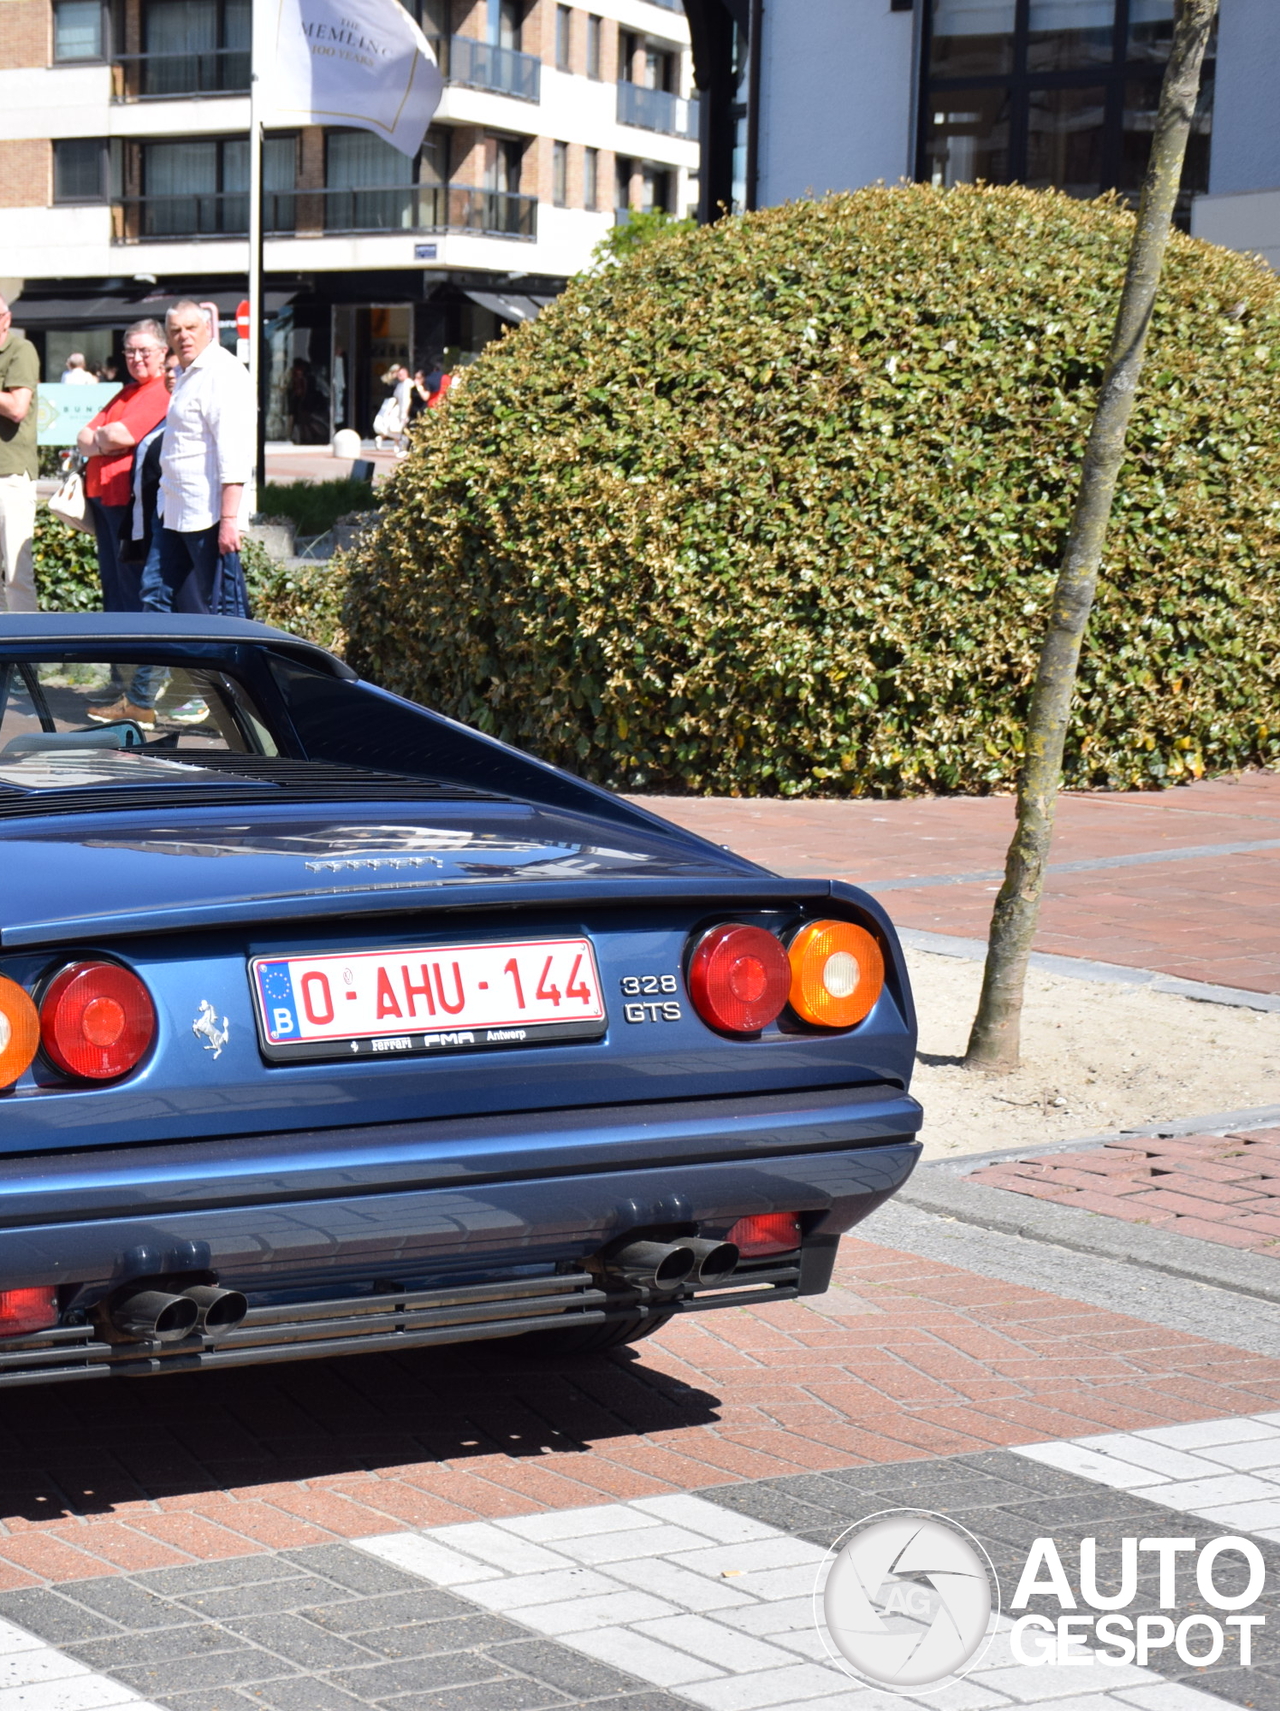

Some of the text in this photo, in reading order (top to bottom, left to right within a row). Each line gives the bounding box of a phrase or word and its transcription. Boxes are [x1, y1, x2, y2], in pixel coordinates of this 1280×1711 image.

[312, 45, 374, 68] 100 YEARS
[622, 974, 678, 994] 328
[273, 1007, 295, 1035] B
[624, 1001, 681, 1022] GTS
[371, 1029, 527, 1052] Ferrari FMA Antwerp
